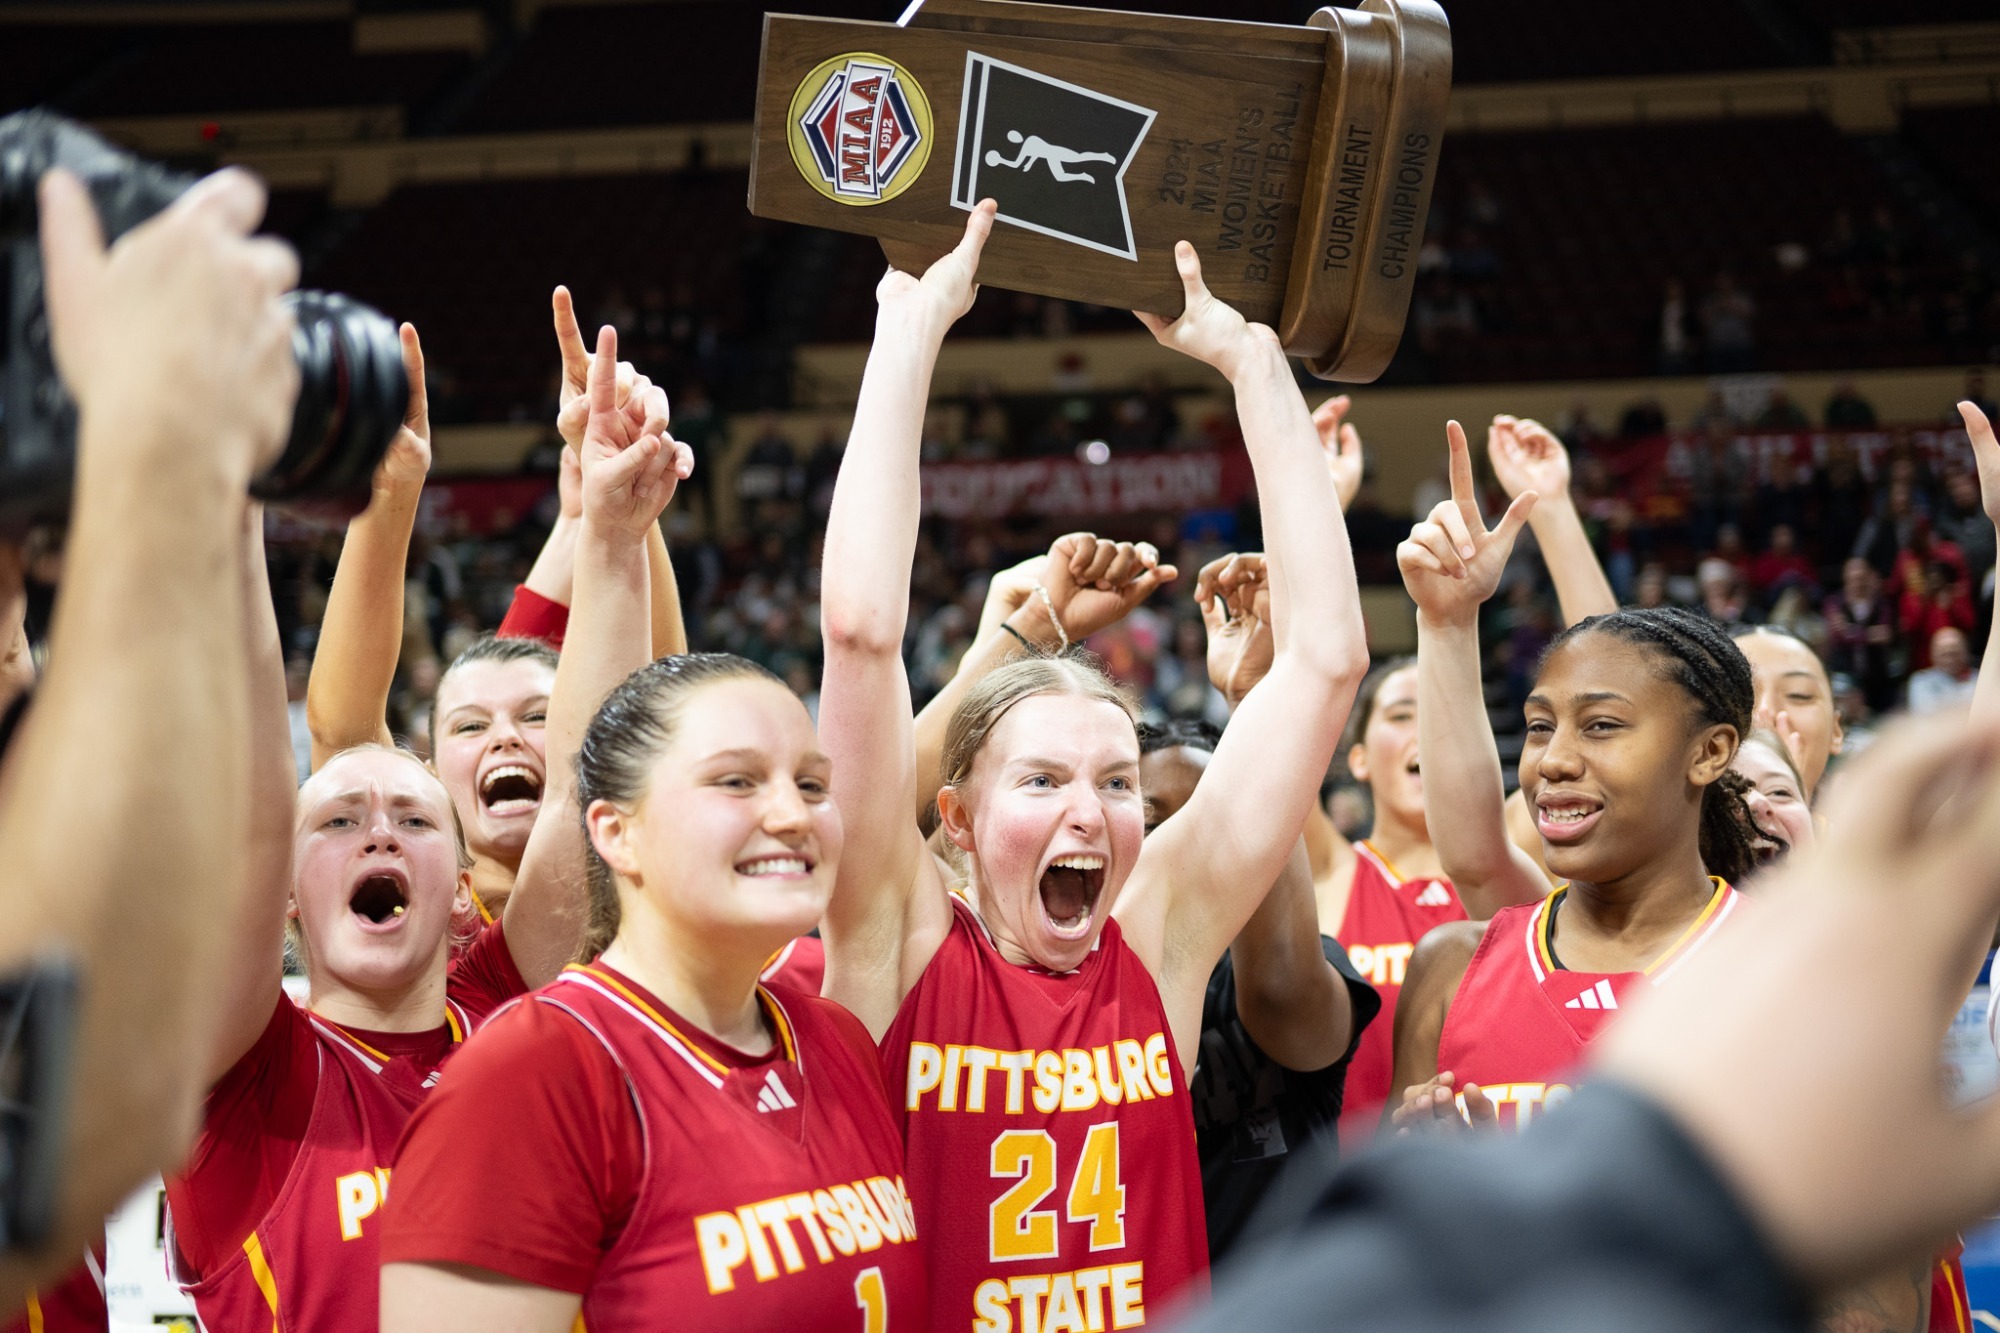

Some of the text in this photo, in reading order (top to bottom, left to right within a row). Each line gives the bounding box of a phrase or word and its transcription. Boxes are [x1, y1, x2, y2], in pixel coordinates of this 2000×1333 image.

[842, 75, 883, 186] MIAA
[880, 118, 894, 150] 1912
[1159, 137, 1194, 206] 2024
[1190, 138, 1228, 214] MIAA
[1216, 107, 1265, 252] WOMEN'S
[1244, 83, 1303, 283] BASKETBALL
[1322, 124, 1373, 272] TOURNAMENT
[1379, 132, 1431, 280] CHAMPIONS
[905, 1033, 1174, 1115] PITTSBURG
[989, 1121, 1127, 1264] 24
[853, 1266, 888, 1333] 1
[972, 1260, 1146, 1333] STATE
